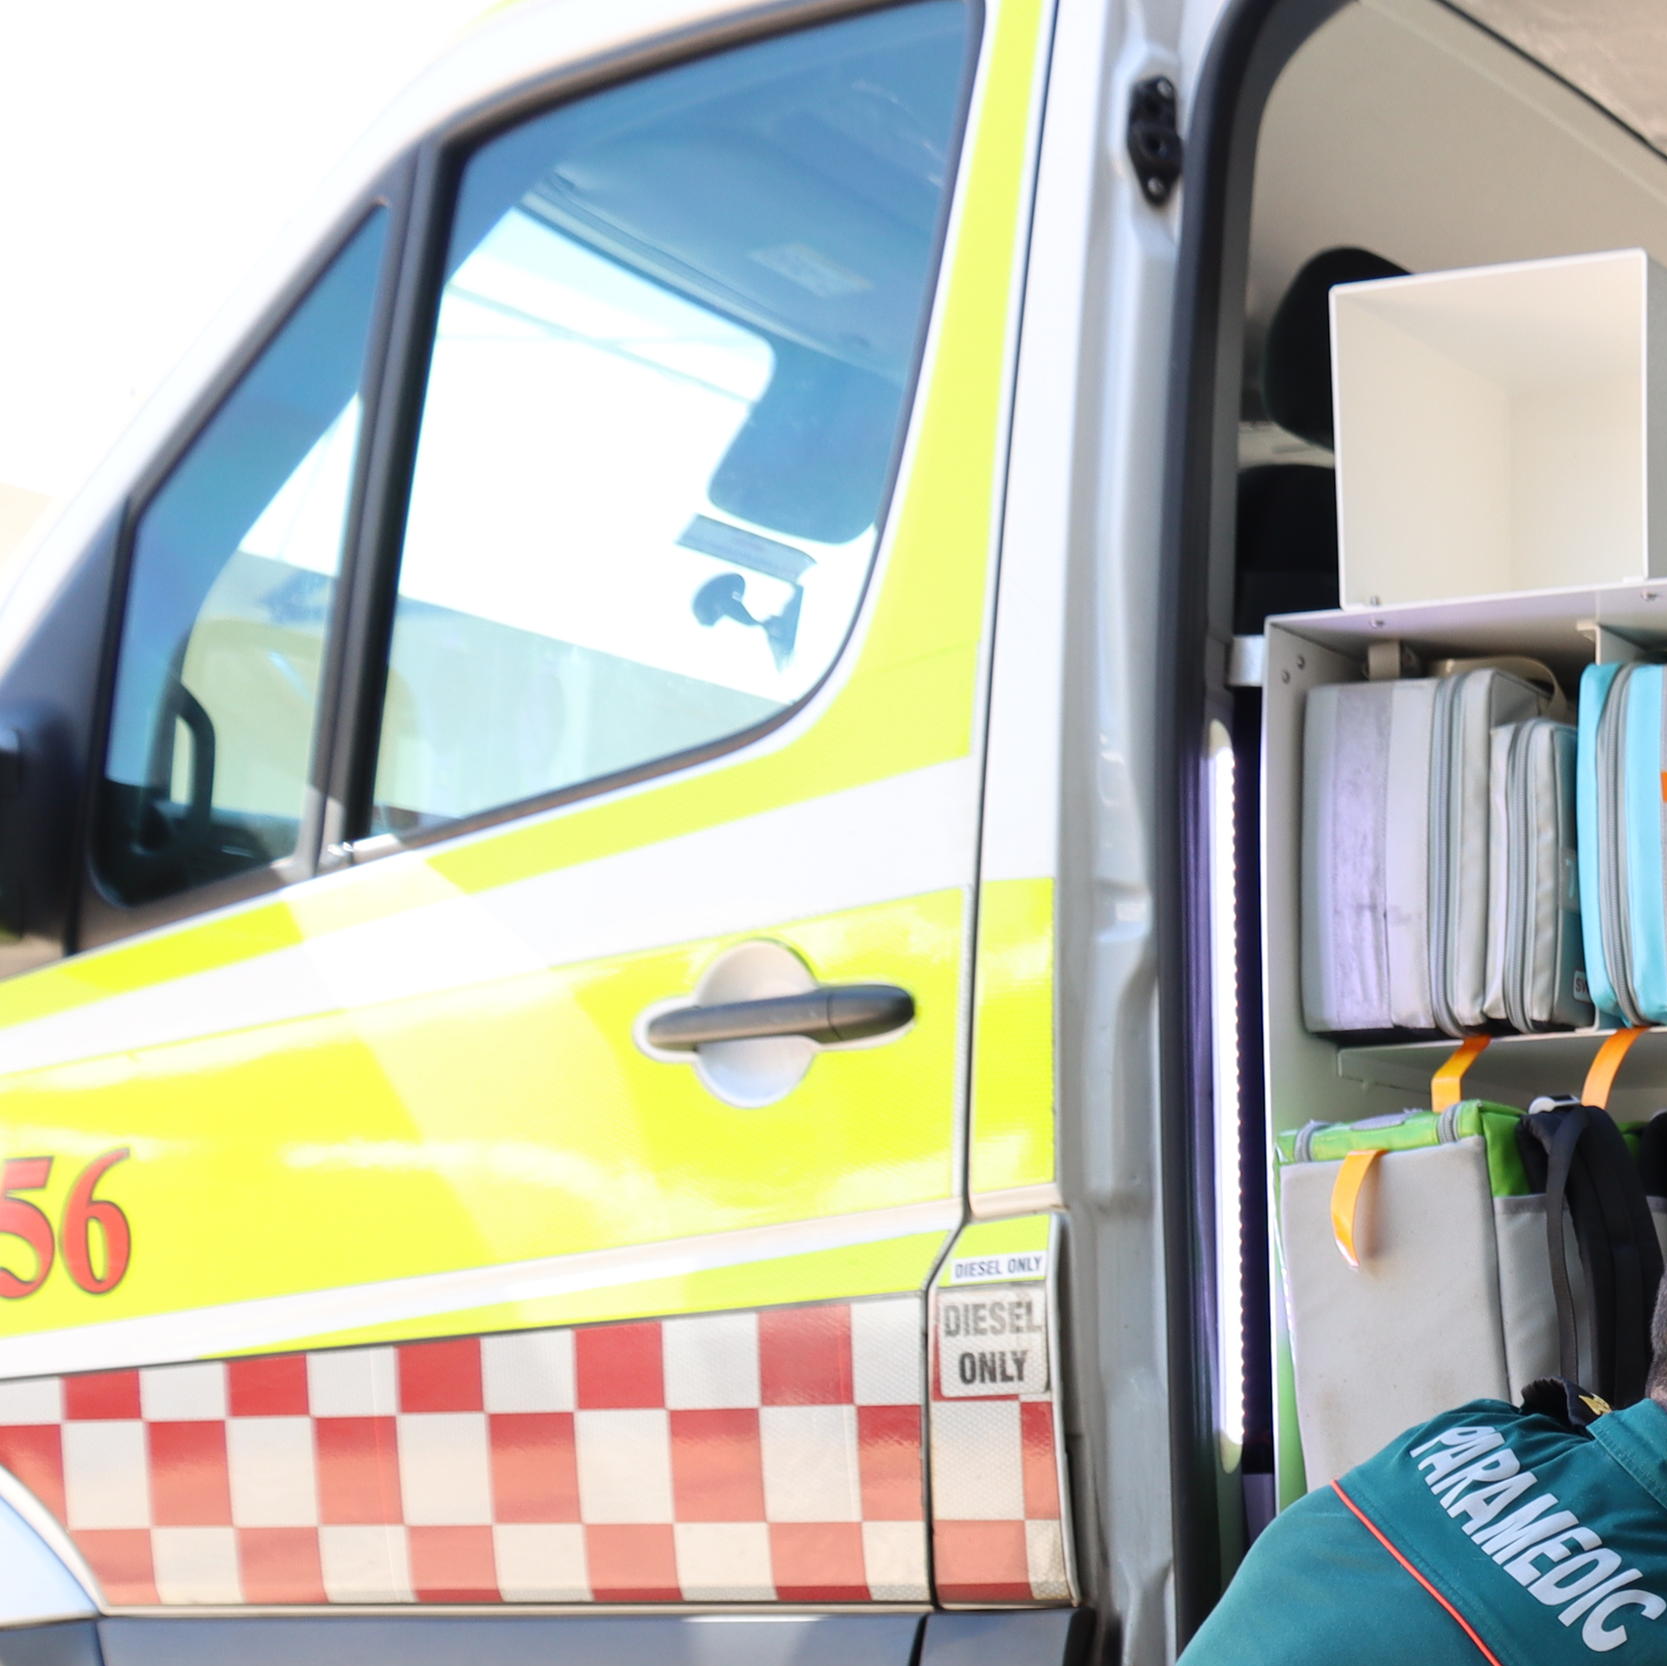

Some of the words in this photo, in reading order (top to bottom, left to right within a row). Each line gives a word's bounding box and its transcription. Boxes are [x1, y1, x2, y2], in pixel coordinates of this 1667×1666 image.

[0, 1146, 132, 1300] 56
[955, 1261, 1001, 1279] DIESEL
[1007, 1255, 1043, 1273] ONLY
[942, 1301, 1043, 1338] DIESEL
[958, 1350, 1029, 1385] ONLY
[1409, 1425, 1667, 1652] PARAMEDIC
